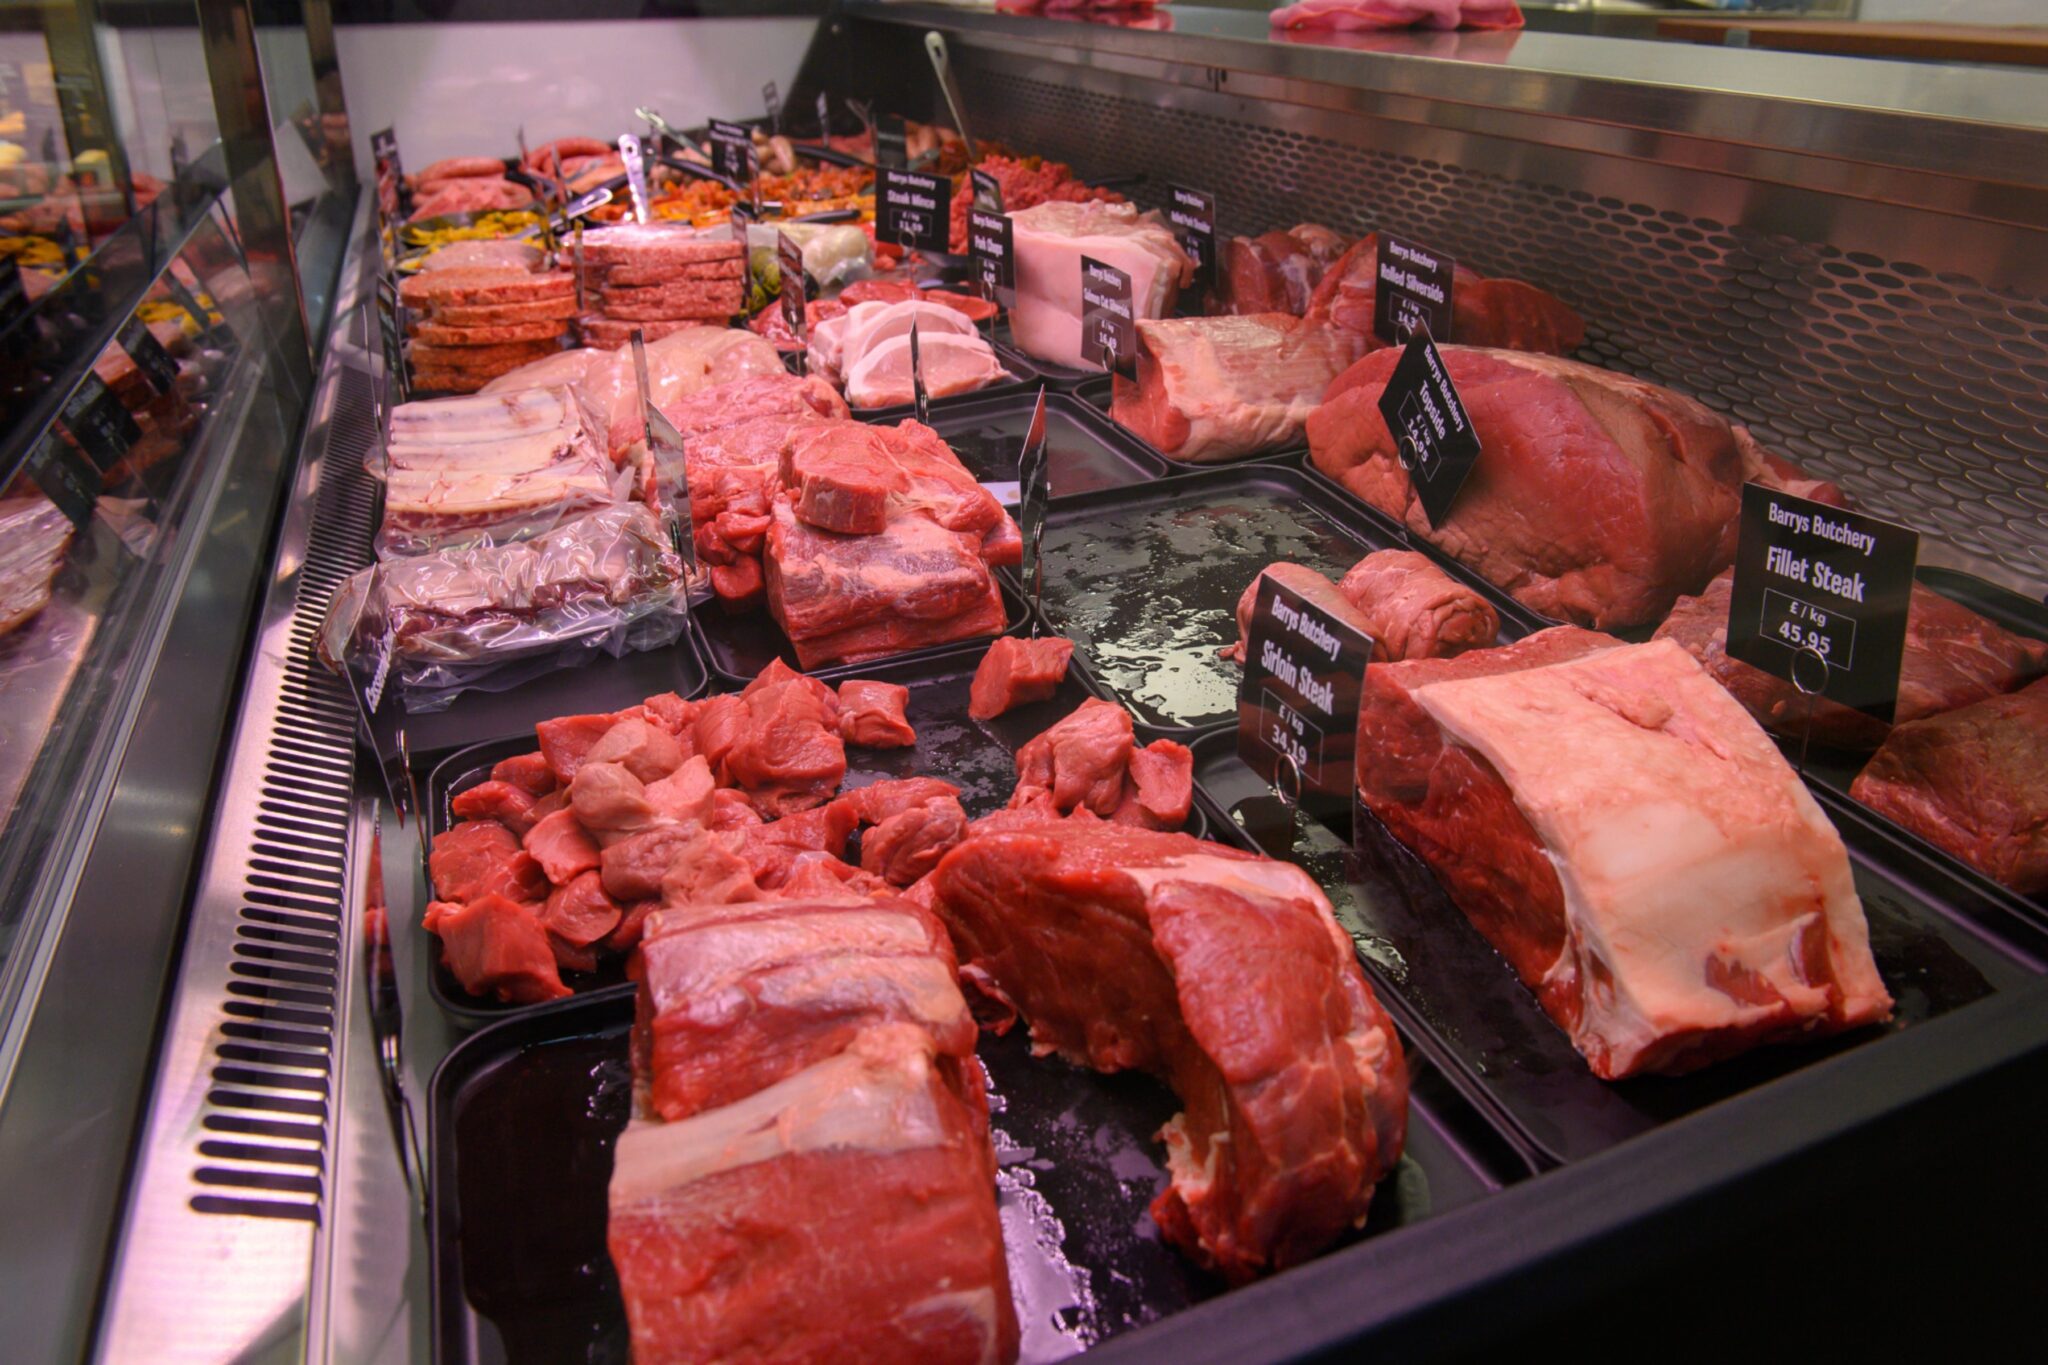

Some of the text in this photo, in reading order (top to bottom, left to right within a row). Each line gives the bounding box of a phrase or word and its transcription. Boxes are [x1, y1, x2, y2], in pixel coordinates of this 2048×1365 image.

[1381, 263, 1444, 304] Rolled Silverside
[1419, 380, 1446, 440] Topside
[1424, 344, 1465, 432] Barrys Butchery
[1768, 502, 1876, 556] Barrys Butchery
[1766, 545, 1866, 603] Fillet Steak
[1271, 594, 1342, 661] Barrys Butchery
[1778, 621, 1831, 654] 45.95
[1789, 601, 1798, 614] £
[1809, 607, 1827, 628] kg
[1261, 639, 1334, 715] Sirloin Steak
[1271, 724, 1308, 766] 34.19
[1292, 715, 1304, 735] kg
